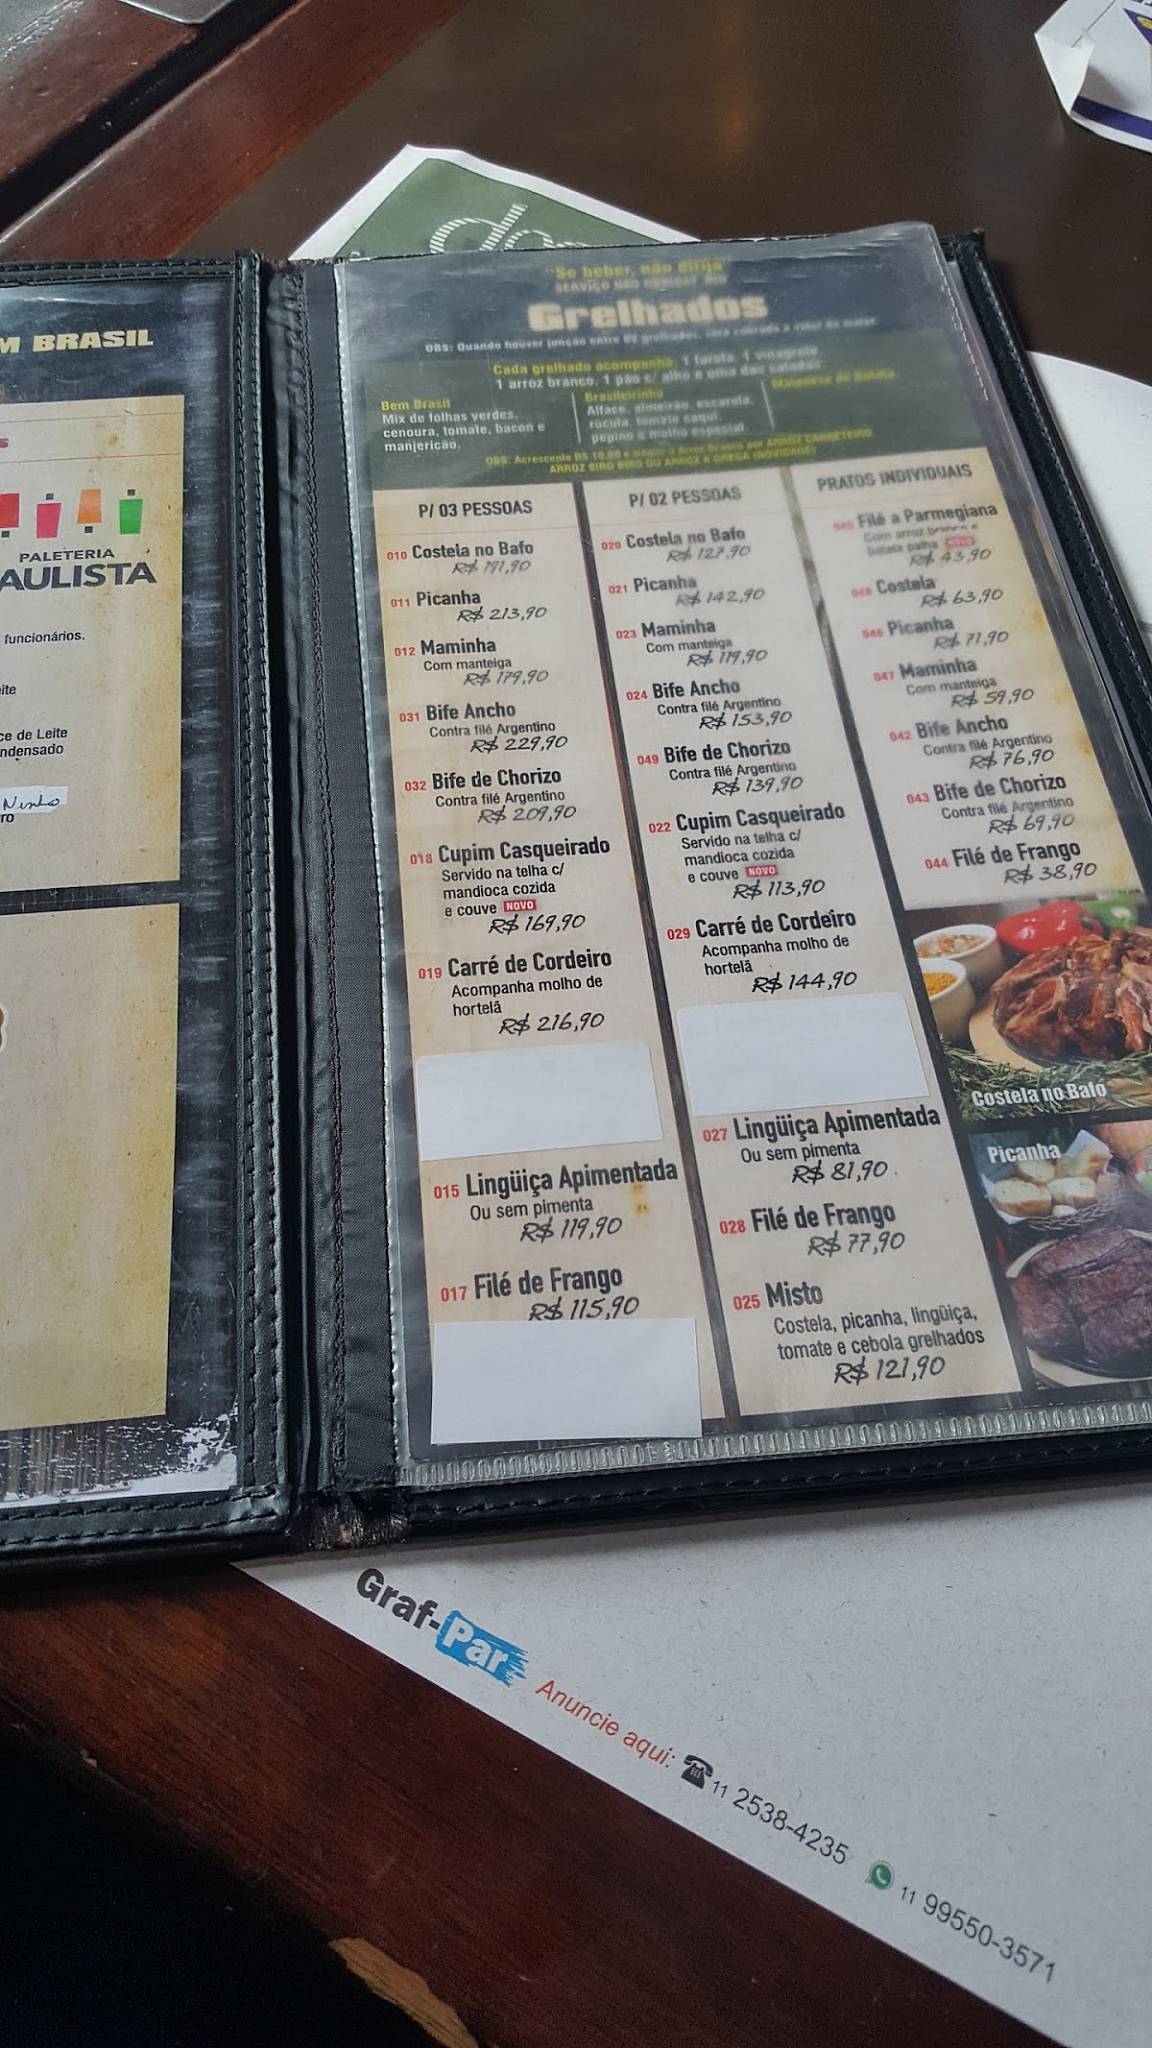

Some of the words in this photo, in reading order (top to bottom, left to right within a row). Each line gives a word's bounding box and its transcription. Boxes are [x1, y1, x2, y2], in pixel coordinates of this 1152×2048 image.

[528, 292, 768, 333] Grelhados
[33, 329, 153, 351] BRASIL
[381, 400, 409, 411] Bem
[414, 399, 450, 409] Brasil
[383, 414, 405, 424] Mix
[410, 413, 424, 423] de
[429, 412, 467, 422] folhas
[496, 423, 533, 433] bacon
[538, 424, 545, 432] e
[817, 472, 875, 492] PRATOS
[881, 464, 972, 485] INDIVIDUAIS
[629, 493, 644, 507] P/
[649, 493, 666, 506] 02
[671, 487, 742, 504] PESSOAS
[419, 504, 433, 518] P/
[440, 503, 457, 517] 03
[463, 500, 532, 516] PESSOAS
[19, 549, 115, 562] PALETERIA
[387, 551, 407, 560] 010
[412, 544, 470, 559] Costela
[475, 546, 494, 557] no
[499, 541, 533, 556] Bafo
[0, 562, 157, 591] AULISTA
[452, 560, 477, 574] R$
[484, 560, 531, 575] 191,90
[391, 599, 410, 607] 011
[416, 590, 481, 606] Picanha
[457, 607, 483, 623] R$
[490, 607, 547, 621] 213,90
[4, 631, 85, 645] funcionários.
[395, 647, 416, 656] 012
[421, 638, 496, 655] Maminha
[424, 660, 451, 671] Com
[457, 657, 511, 670] manteiga
[464, 671, 490, 686] R$
[497, 670, 549, 685] 179,90
[400, 712, 420, 722] 031
[426, 703, 459, 721] Bife
[464, 702, 516, 718] Ancho
[17, 729, 32, 740] de
[37, 728, 68, 739] Leite
[430, 726, 470, 737] Contra
[475, 724, 493, 735] filé
[497, 722, 555, 734] Argentino
[916, 721, 949, 739] Bife
[956, 715, 1008, 735] Ancho
[0, 744, 64, 757] ndensado
[470, 736, 499, 753] R$
[505, 736, 568, 751] 229,90
[969, 751, 997, 769] R$
[1004, 750, 1054, 767] 76,90
[405, 781, 426, 791] 032
[432, 772, 466, 789] Bife
[472, 772, 492, 787] de
[497, 768, 561, 785] Chorizo
[906, 794, 929, 804] 043
[933, 783, 968, 801] Bife
[974, 781, 995, 797] de
[1000, 774, 1066, 794] Chorizo
[436, 795, 477, 807] Contra
[483, 793, 500, 804] filé
[505, 791, 565, 805] Argentino
[478, 805, 506, 824] R$
[513, 805, 576, 822] 209,90
[988, 814, 1017, 834] R$
[1024, 814, 1075, 832] 69,90
[410, 854, 432, 865] 018
[439, 844, 495, 866] Cupim
[500, 836, 610, 862] Casqueirado
[925, 859, 948, 869] 044
[952, 847, 985, 867] Filé
[992, 845, 1012, 863] de
[1016, 842, 1081, 863] Frango
[442, 867, 492, 882] Servido
[497, 869, 512, 878] na
[517, 865, 547, 877] telha
[552, 863, 564, 876] c/
[1004, 864, 1033, 884] R$
[1039, 863, 1097, 881] 38,90
[443, 886, 509, 899] mandioca
[513, 882, 555, 894] cozida
[445, 907, 452, 917] e
[457, 904, 496, 916] couve
[505, 901, 534, 911] NOVO
[488, 914, 519, 935] R$
[526, 914, 585, 932] 169,90
[667, 928, 690, 940] 029
[696, 917, 746, 938] Carré
[751, 917, 773, 933] de
[778, 910, 856, 931] Cordeiro
[418, 968, 442, 979] 019
[448, 955, 499, 977] Carré
[505, 955, 527, 973] de
[533, 949, 612, 971] Cordeiro
[452, 982, 534, 998] Acompanha
[539, 978, 581, 990] molho
[587, 977, 603, 987] de
[752, 972, 782, 994] R$
[789, 972, 857, 991] 144,90
[453, 1001, 502, 1016] hortelã
[499, 1013, 530, 1036] R$
[537, 1012, 604, 1032] 216,90
[972, 1087, 1039, 1106] Costela
[1043, 1089, 1064, 1100] no
[1066, 1082, 1107, 1099] Bafo
[703, 1128, 727, 1142] 027
[733, 1115, 818, 1143] Lingüiça
[824, 1105, 940, 1137] Apimentada
[988, 1143, 1061, 1163] Picanha
[434, 1185, 459, 1199] 015
[466, 1169, 553, 1199] Lingüiça
[560, 1158, 678, 1193] Apimentada
[792, 1160, 824, 1185] R$
[831, 1161, 887, 1182] 81,90
[470, 1205, 490, 1220] Ou
[497, 1204, 528, 1218] sem
[534, 1198, 593, 1221] pimenta
[520, 1216, 553, 1243] R$
[561, 1217, 622, 1239] 119,90
[441, 1286, 467, 1302] 017
[474, 1272, 511, 1299] Filé
[518, 1270, 543, 1295] de
[550, 1267, 622, 1294] Frango
[733, 1295, 761, 1310] 025
[765, 1281, 823, 1307] Misto
[529, 1297, 563, 1321] R$
[571, 1296, 639, 1320] 115,90
[774, 1315, 837, 1335] Costela,
[842, 1310, 907, 1333] picanha,
[912, 1303, 977, 1329] lingüiça,
[777, 1341, 832, 1360] tomate
[838, 1342, 846, 1354] e
[852, 1335, 904, 1353] cebola
[909, 1329, 985, 1352] grelhados
[834, 1356, 868, 1385] R$
[876, 1355, 945, 1382] 121,90
[535, 1680, 619, 1736] Anuncie
[623, 1731, 675, 1768] aqui:
[712, 1780, 728, 1798] 11
[733, 1787, 848, 1864] 2538-4235
[900, 1886, 916, 1905] 11
[923, 1894, 1056, 1983] 99550-3571
